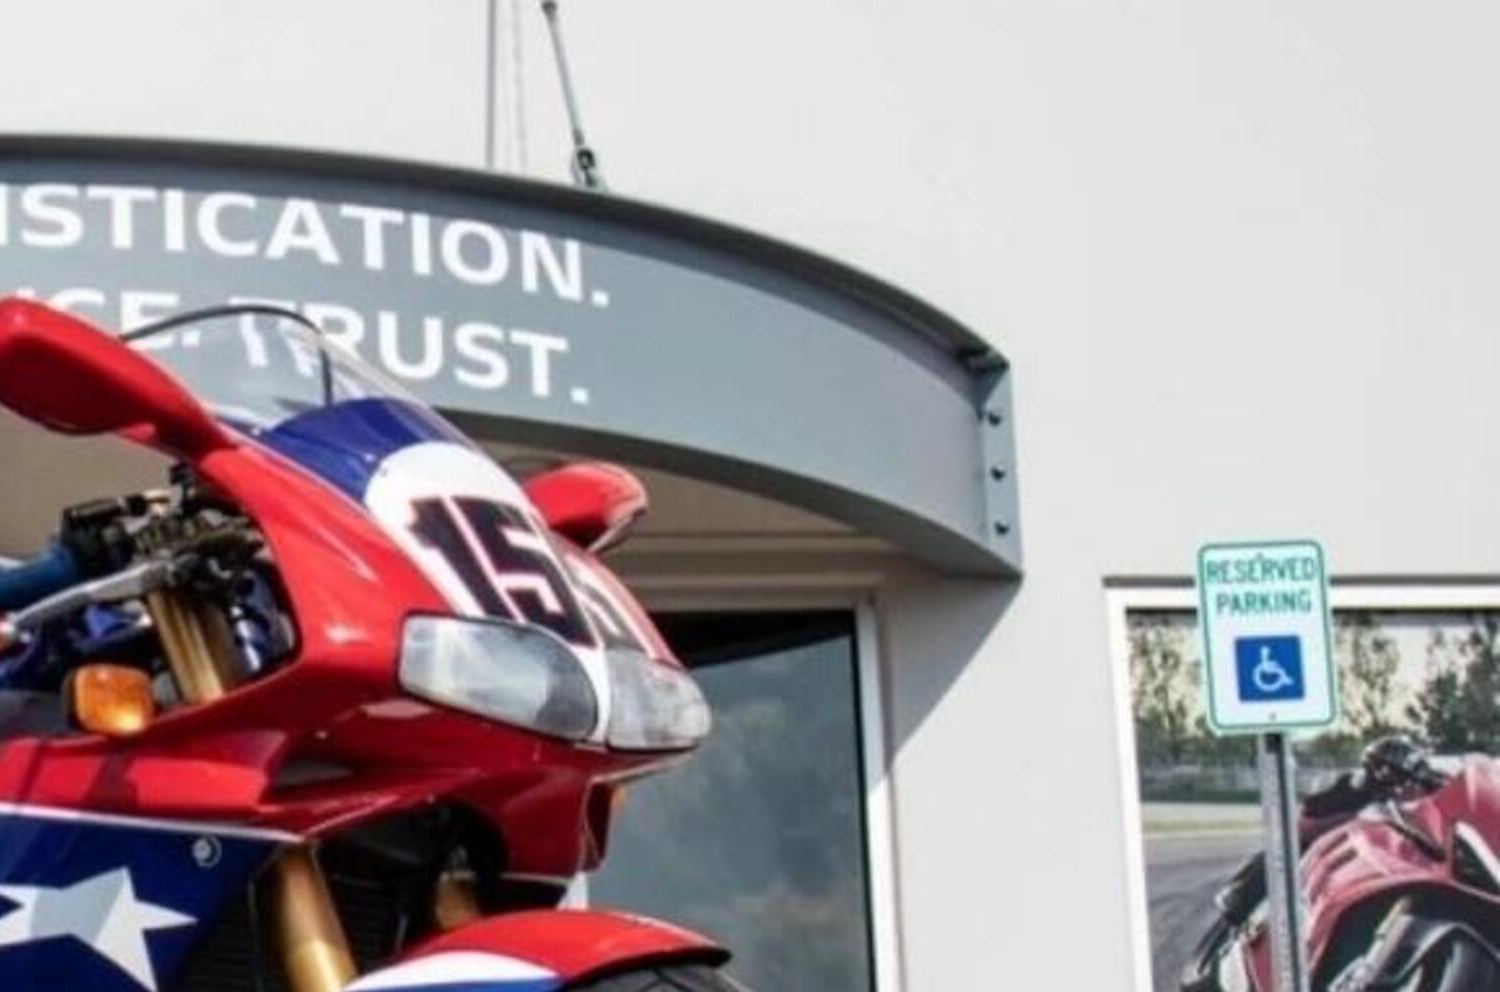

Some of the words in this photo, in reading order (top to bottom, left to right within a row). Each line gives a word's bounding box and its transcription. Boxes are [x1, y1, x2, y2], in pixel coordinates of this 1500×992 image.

[228, 296, 589, 404] TRUST.
[1205, 555, 1317, 584] RESERVED
[1216, 589, 1312, 615] PARKING
